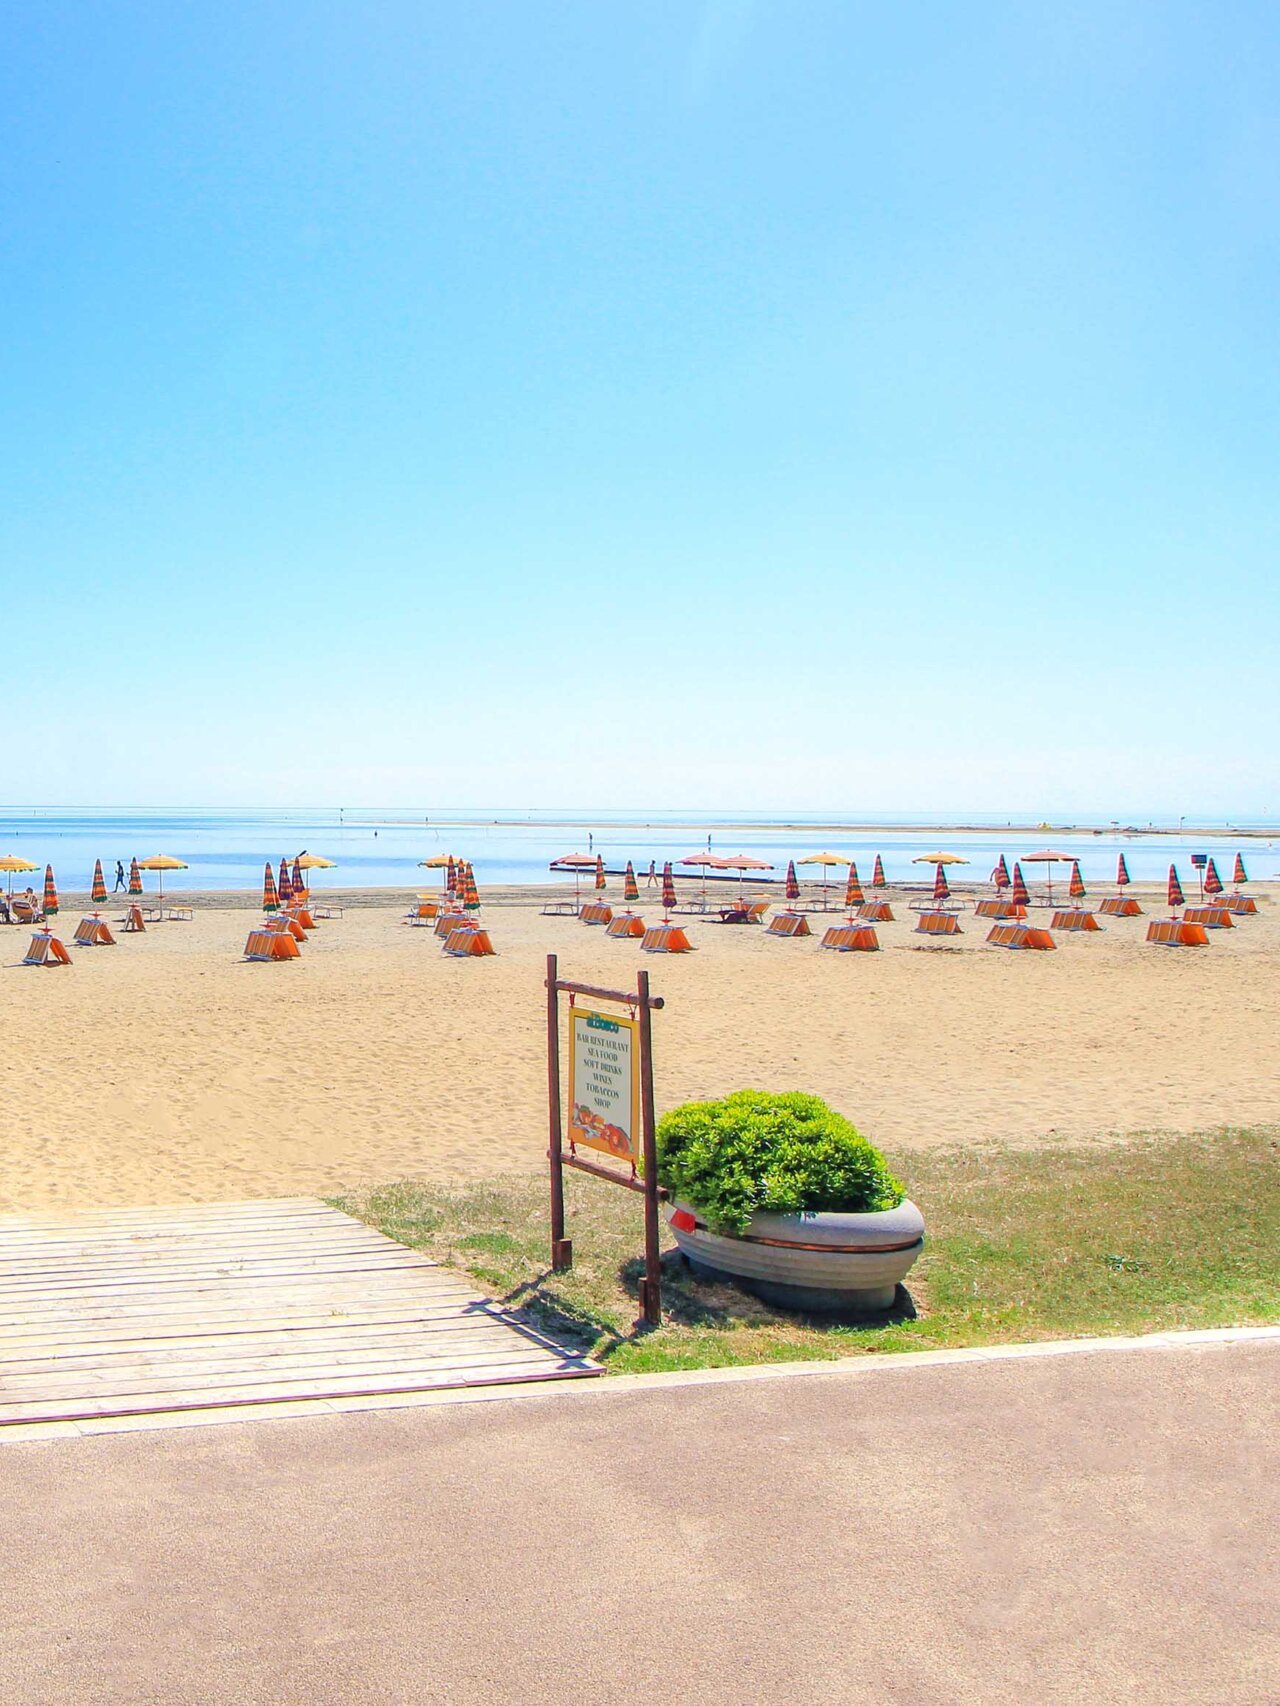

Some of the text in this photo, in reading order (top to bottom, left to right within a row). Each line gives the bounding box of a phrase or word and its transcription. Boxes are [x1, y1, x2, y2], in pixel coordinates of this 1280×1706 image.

[576, 1033, 629, 1052] BAR RESTAURANT
[600, 1051, 618, 1062] FOOD
[583, 1059, 622, 1075] SOFT DRINKS
[592, 1073, 613, 1085] WINES
[586, 1083, 620, 1099] TOBACCOS
[593, 1097, 612, 1109] SHOP
